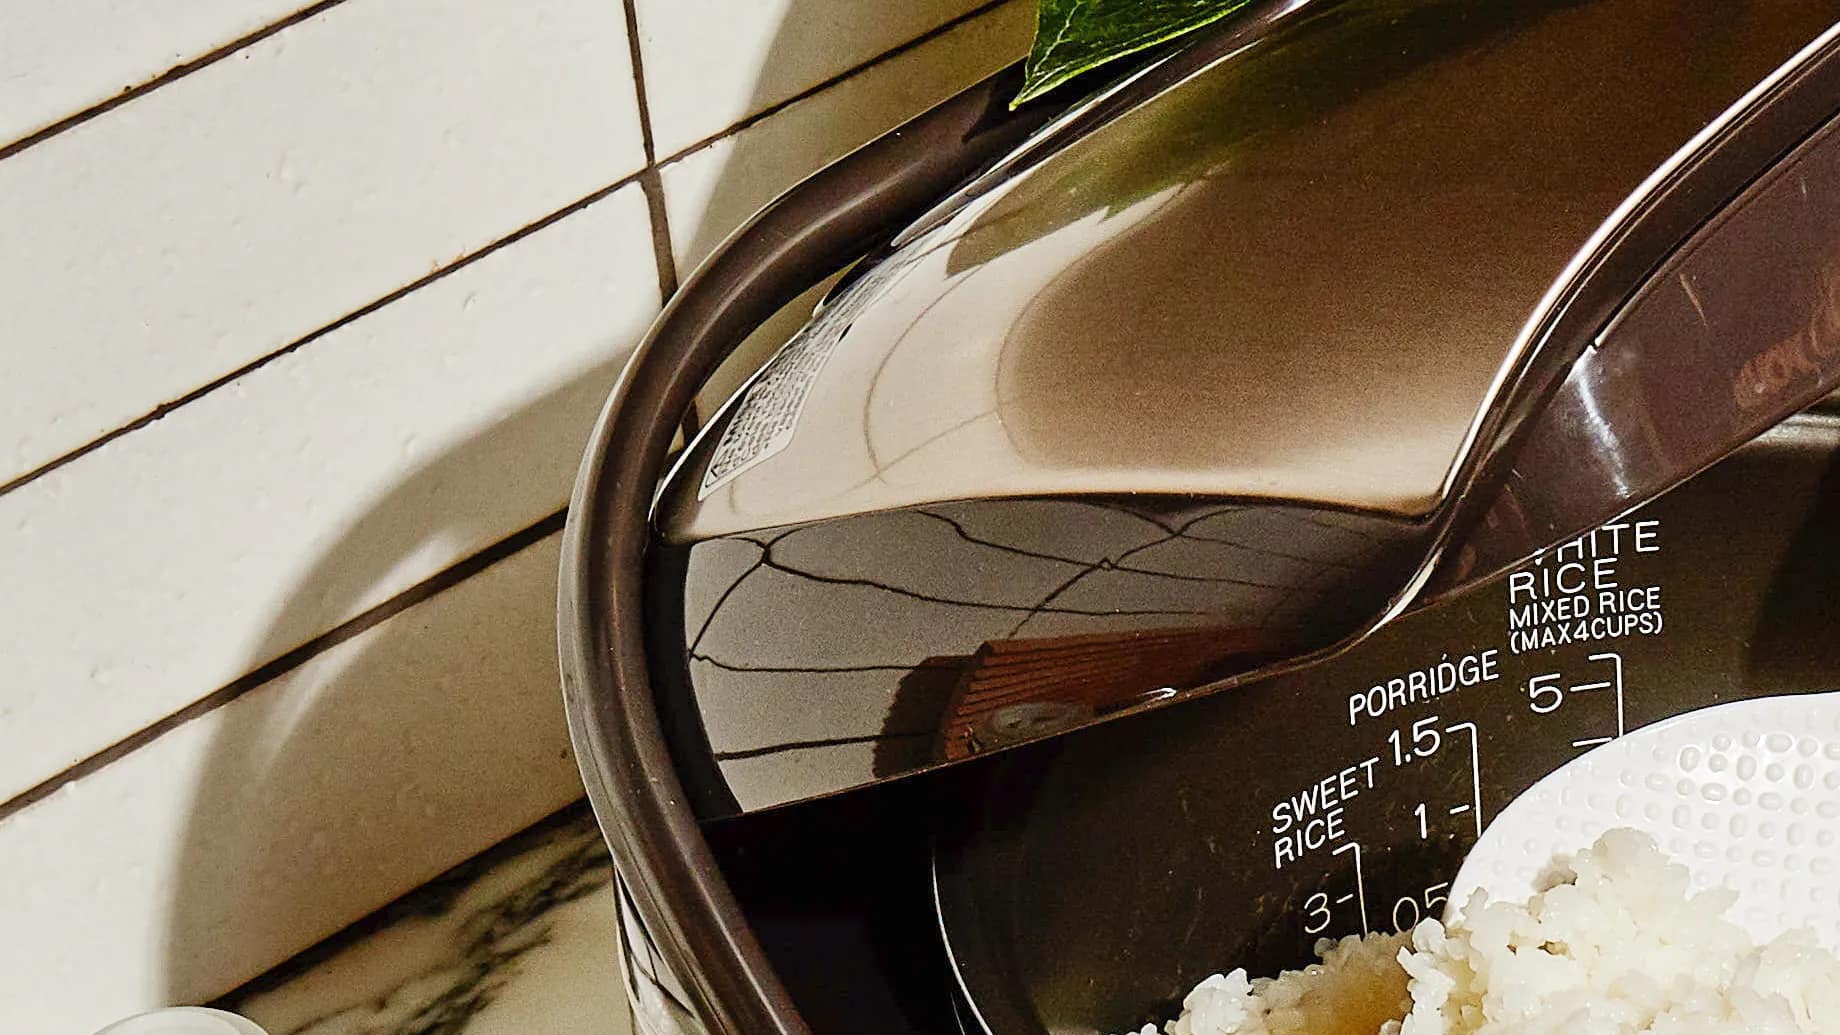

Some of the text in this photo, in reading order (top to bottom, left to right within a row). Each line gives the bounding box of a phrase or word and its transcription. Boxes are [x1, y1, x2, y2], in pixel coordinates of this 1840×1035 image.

[1535, 520, 1660, 566] HITE
[1509, 557, 1618, 604] RICE
[1509, 586, 1661, 630] MIXED RICE
[1510, 611, 1663, 654] (MAX4CUPS)
[1348, 649, 1500, 726] PORRIDGE
[1528, 673, 1564, 714] 5
[1388, 716, 1441, 767] 1.5
[1271, 756, 1380, 834] SWEET
[1274, 807, 1346, 869] RICE
[1414, 803, 1429, 839] 1
[1303, 892, 1331, 934] 3
